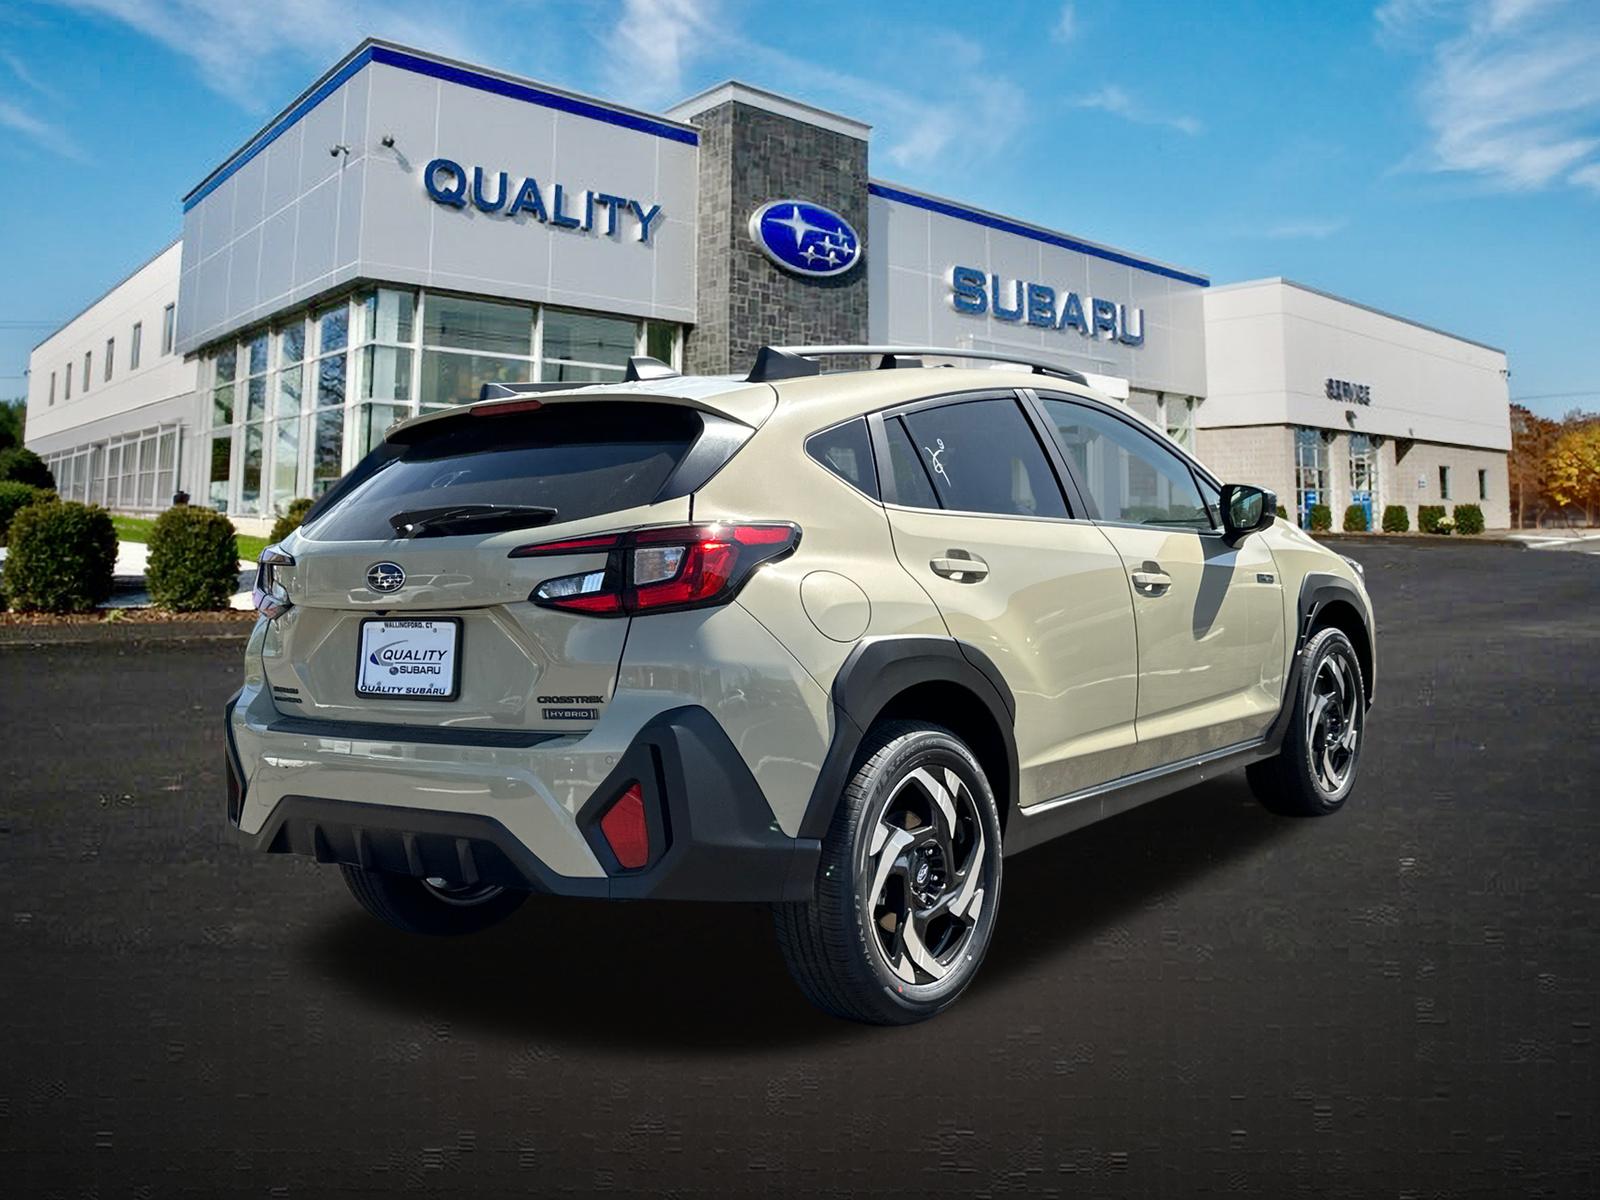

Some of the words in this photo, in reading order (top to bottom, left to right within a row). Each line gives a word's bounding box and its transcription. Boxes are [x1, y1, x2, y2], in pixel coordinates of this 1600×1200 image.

[424, 158, 661, 243] QUALITY
[949, 265, 1145, 346] SUBARU
[1325, 378, 1371, 406] SERVICE
[425, 621, 433, 629] CT
[383, 649, 448, 661] QUALITY
[400, 665, 441, 675] SUBARU
[360, 685, 404, 694] QUALITY
[405, 686, 446, 695] SUBARU
[536, 695, 605, 704] CROSSTREK
